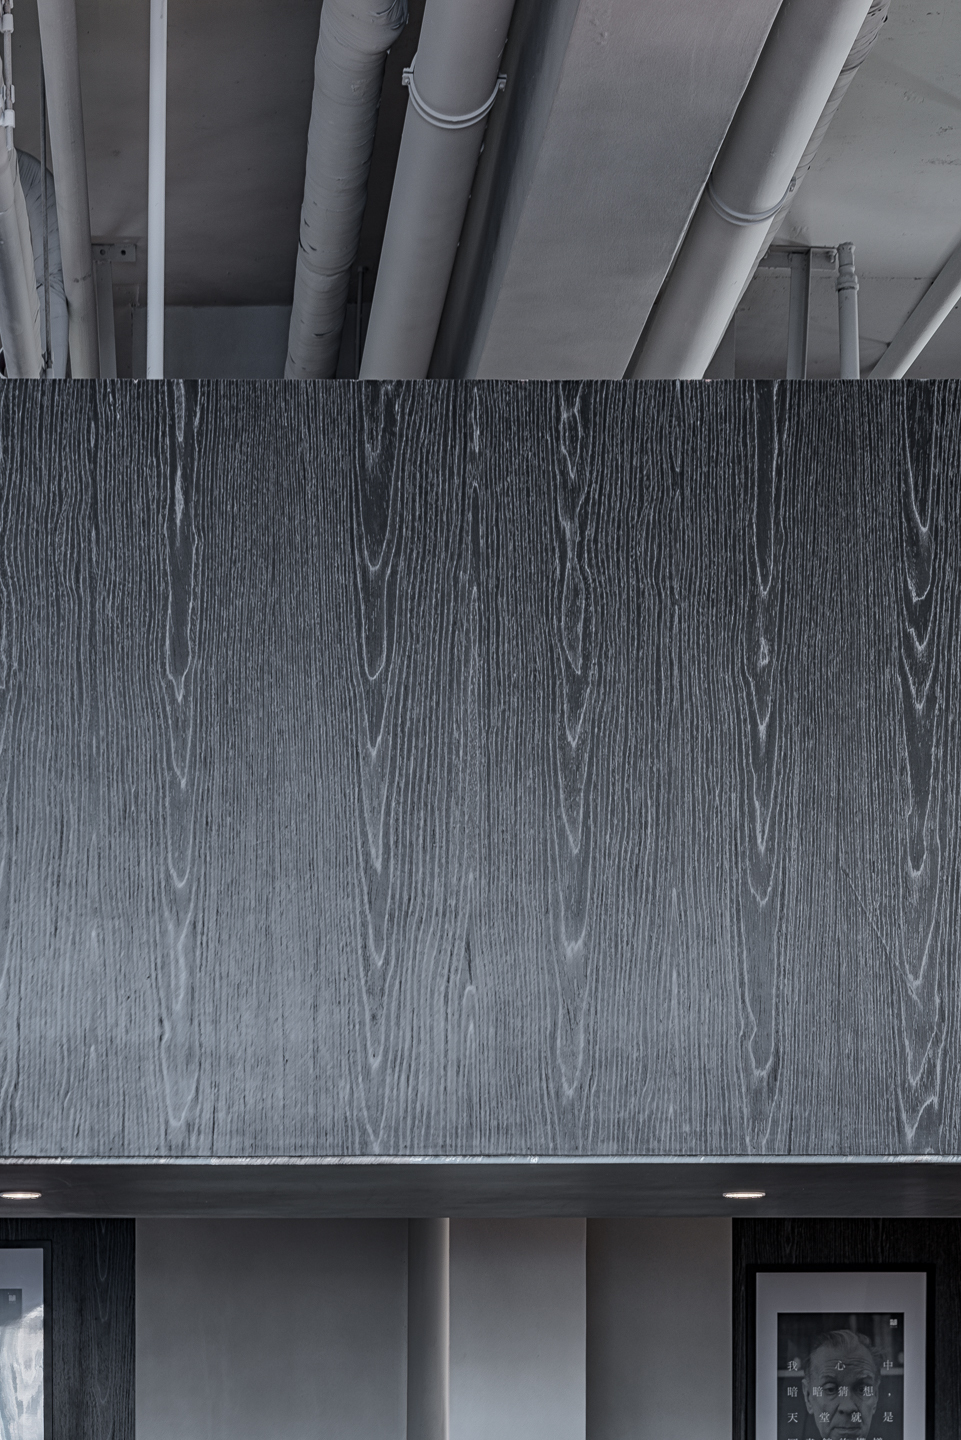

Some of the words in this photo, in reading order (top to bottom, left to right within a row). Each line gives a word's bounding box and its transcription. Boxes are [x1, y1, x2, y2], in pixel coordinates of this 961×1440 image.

[787, 1360, 893, 1371] 我心中
[787, 1412, 893, 1423] 天堂就是
